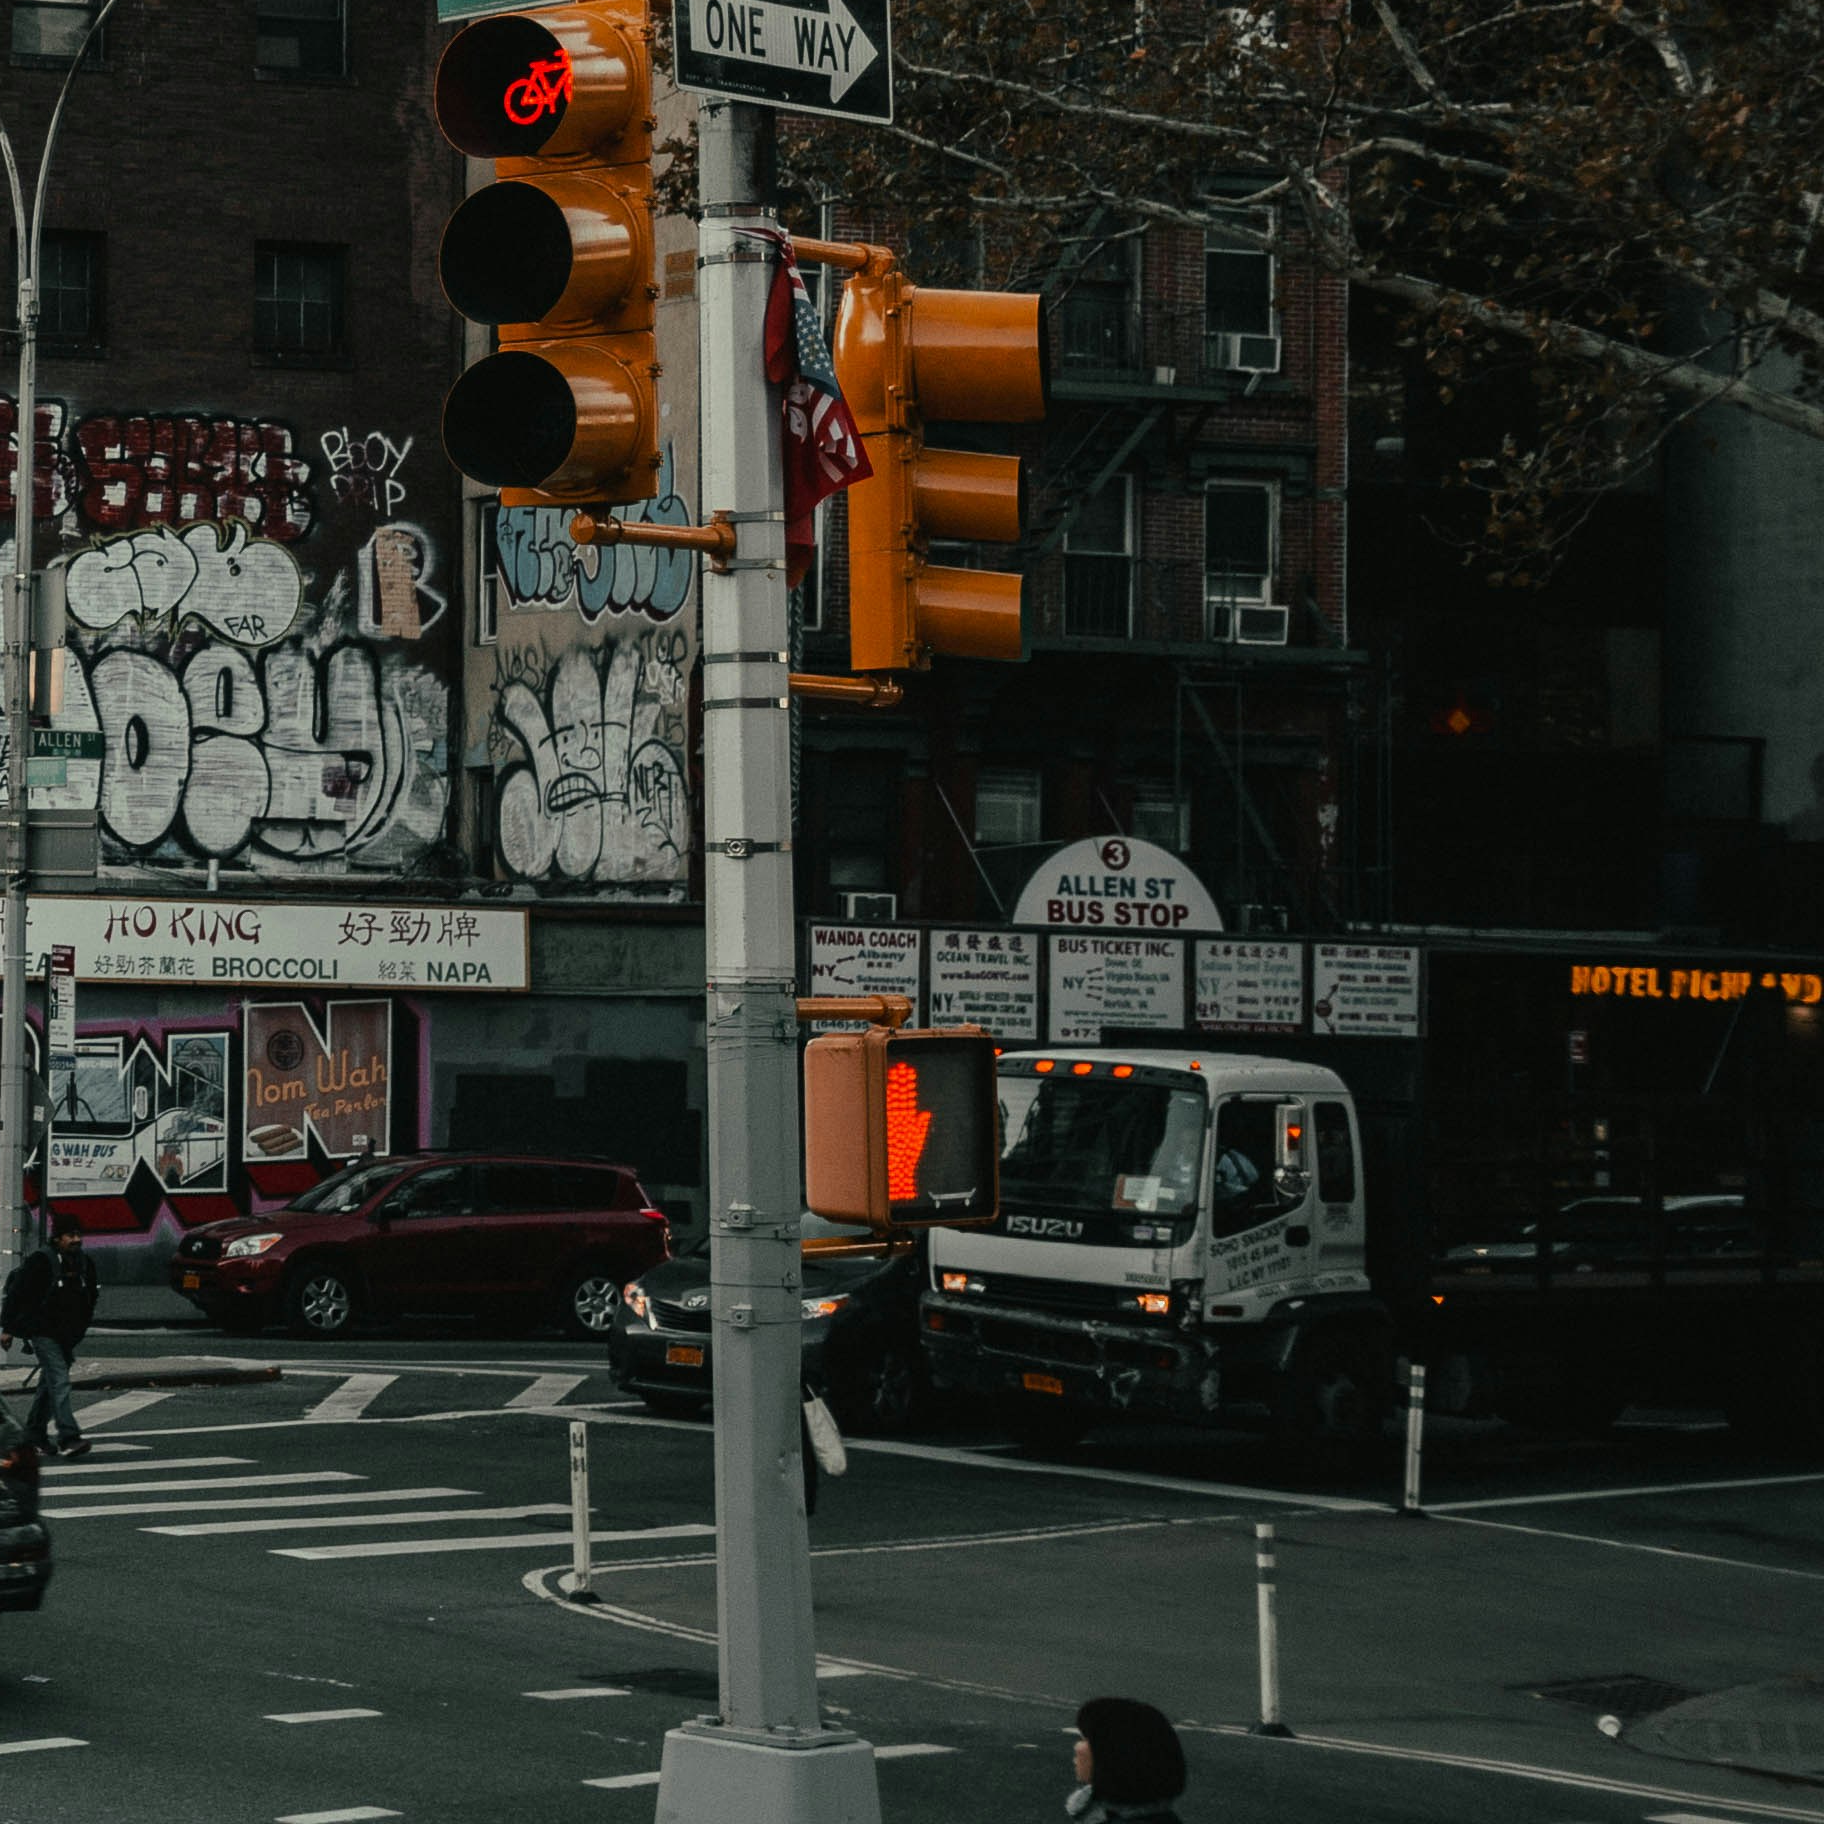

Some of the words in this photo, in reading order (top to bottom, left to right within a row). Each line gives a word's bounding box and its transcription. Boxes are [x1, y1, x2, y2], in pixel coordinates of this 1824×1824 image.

[794, 15, 855, 73] WAY
[38, 732, 82, 748] ALLEN
[1107, 843, 1125, 867] 3
[1058, 875, 1140, 898] ALLEN
[1145, 878, 1176, 900] ST
[1048, 900, 1104, 925] BUS
[1114, 902, 1190, 928] STOP
[104, 905, 156, 943] HO
[170, 907, 262, 947] KING
[338, 911, 481, 947] 好勁牌
[815, 929, 864, 946] WANDA
[869, 932, 916, 948] COACH
[1058, 938, 1088, 954] BUS
[1091, 939, 1142, 956] TICKET
[1145, 942, 1175, 957] INC.
[857, 950, 906, 962] Albany
[937, 951, 971, 963] OCEAN
[975, 952, 1008, 964] TRAVEL
[1013, 953, 1032, 966] INC.
[212, 957, 338, 980] BROCCOLI
[427, 962, 492, 984] NAPA
[812, 965, 837, 977] NY
[1570, 965, 1664, 999] HOTEL
[1062, 977, 1085, 990] NY
[932, 992, 954, 1014] NY
[316, 1049, 387, 1093] Wah
[63, 1144, 89, 1158] WAH
[93, 1144, 118, 1158] BUS
[1006, 1214, 1084, 1238] ISUZU
